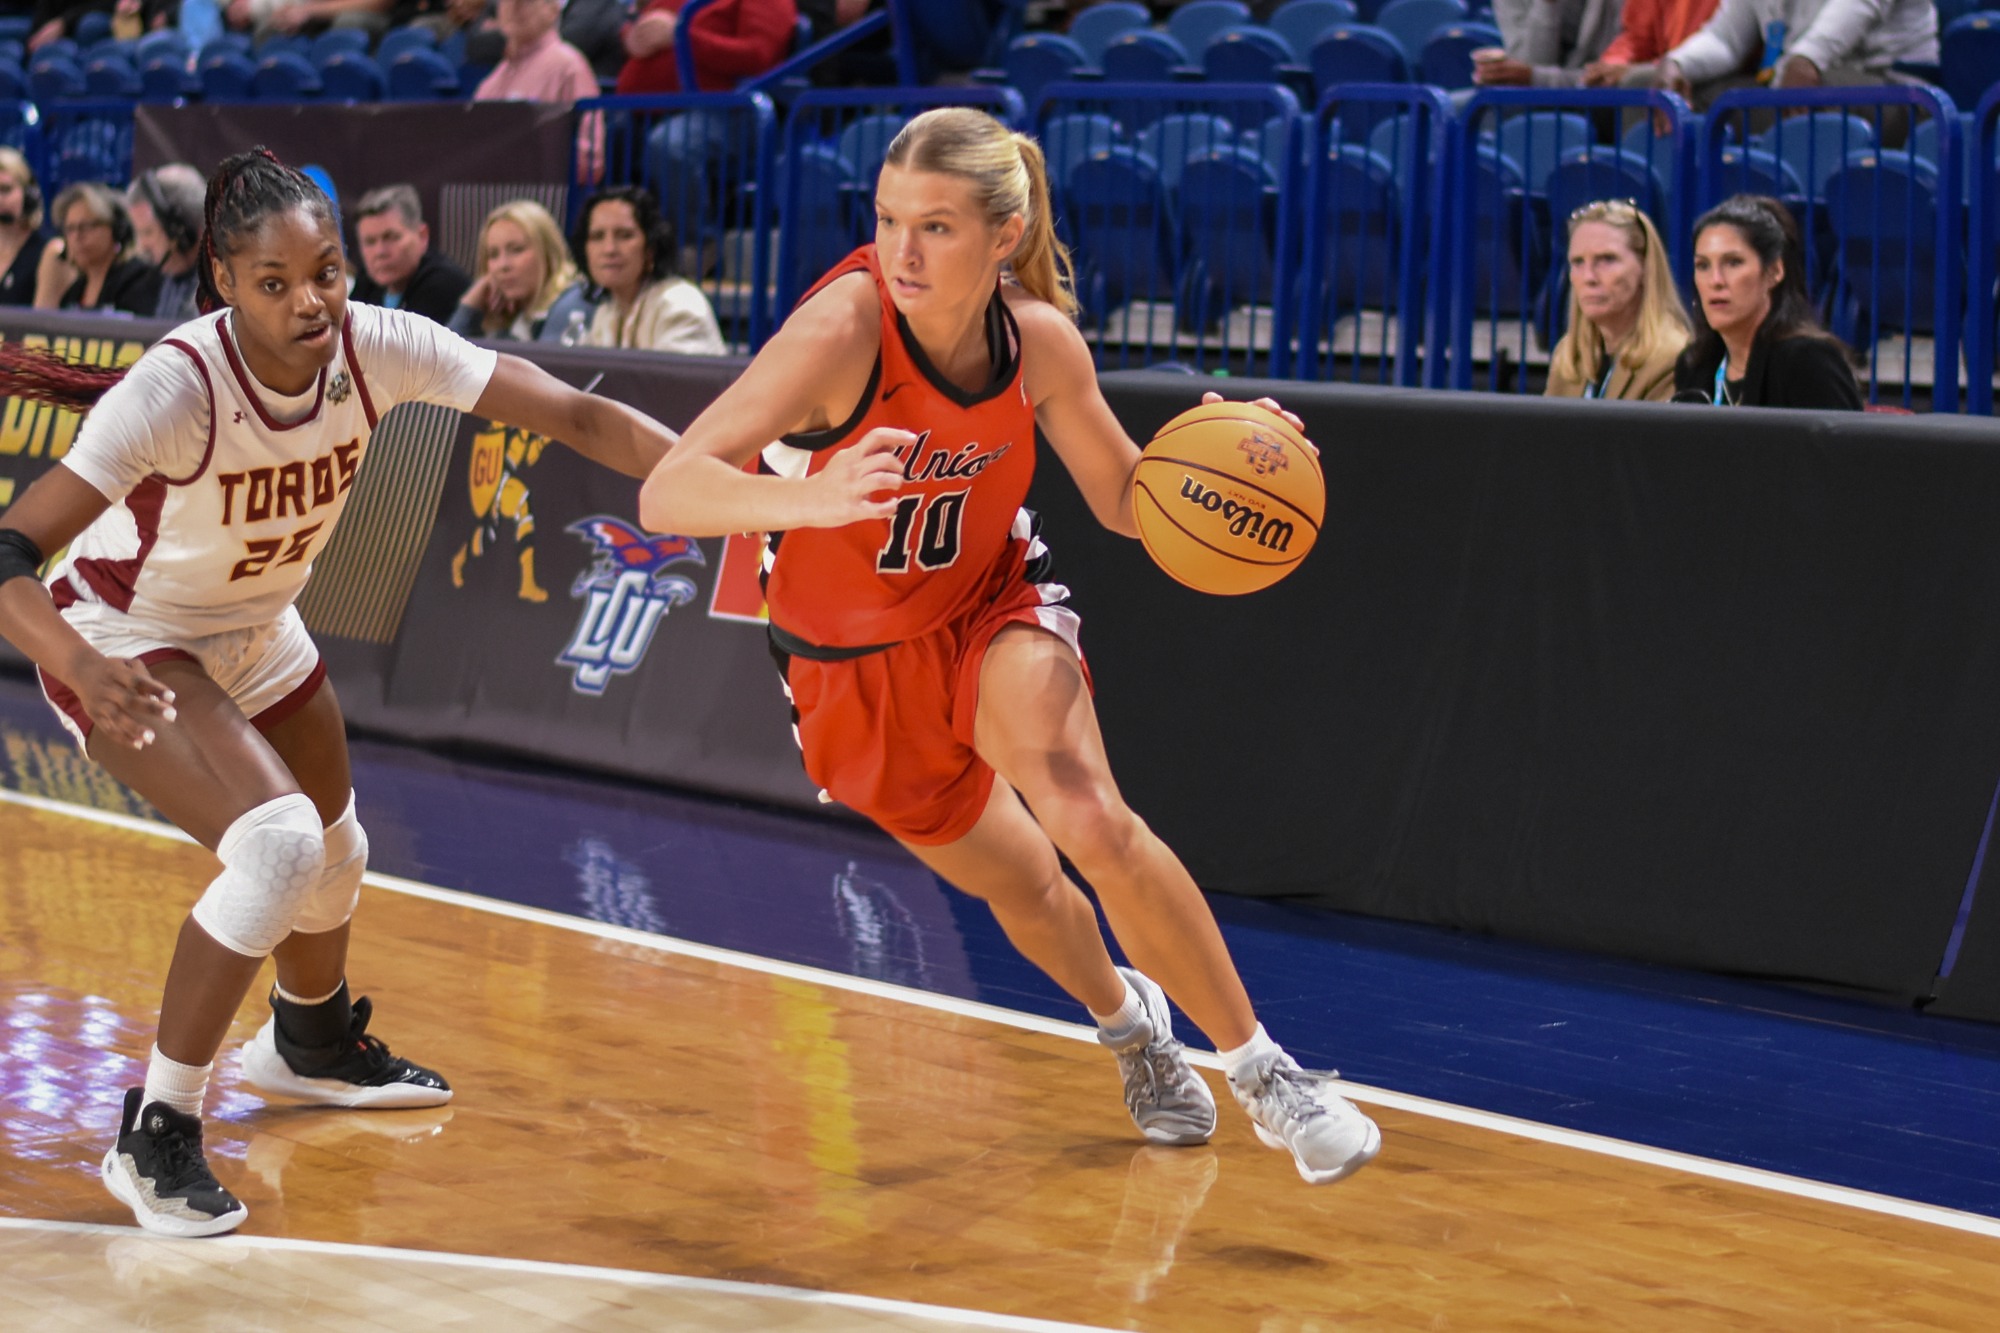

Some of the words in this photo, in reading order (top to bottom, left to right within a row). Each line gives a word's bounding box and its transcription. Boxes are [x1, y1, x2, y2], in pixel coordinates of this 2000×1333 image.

[217, 437, 360, 526] TOROS
[473, 447, 502, 487] GU
[228, 519, 326, 582] 25
[876, 486, 972, 575] 10
[1180, 474, 1295, 554] Wilson
